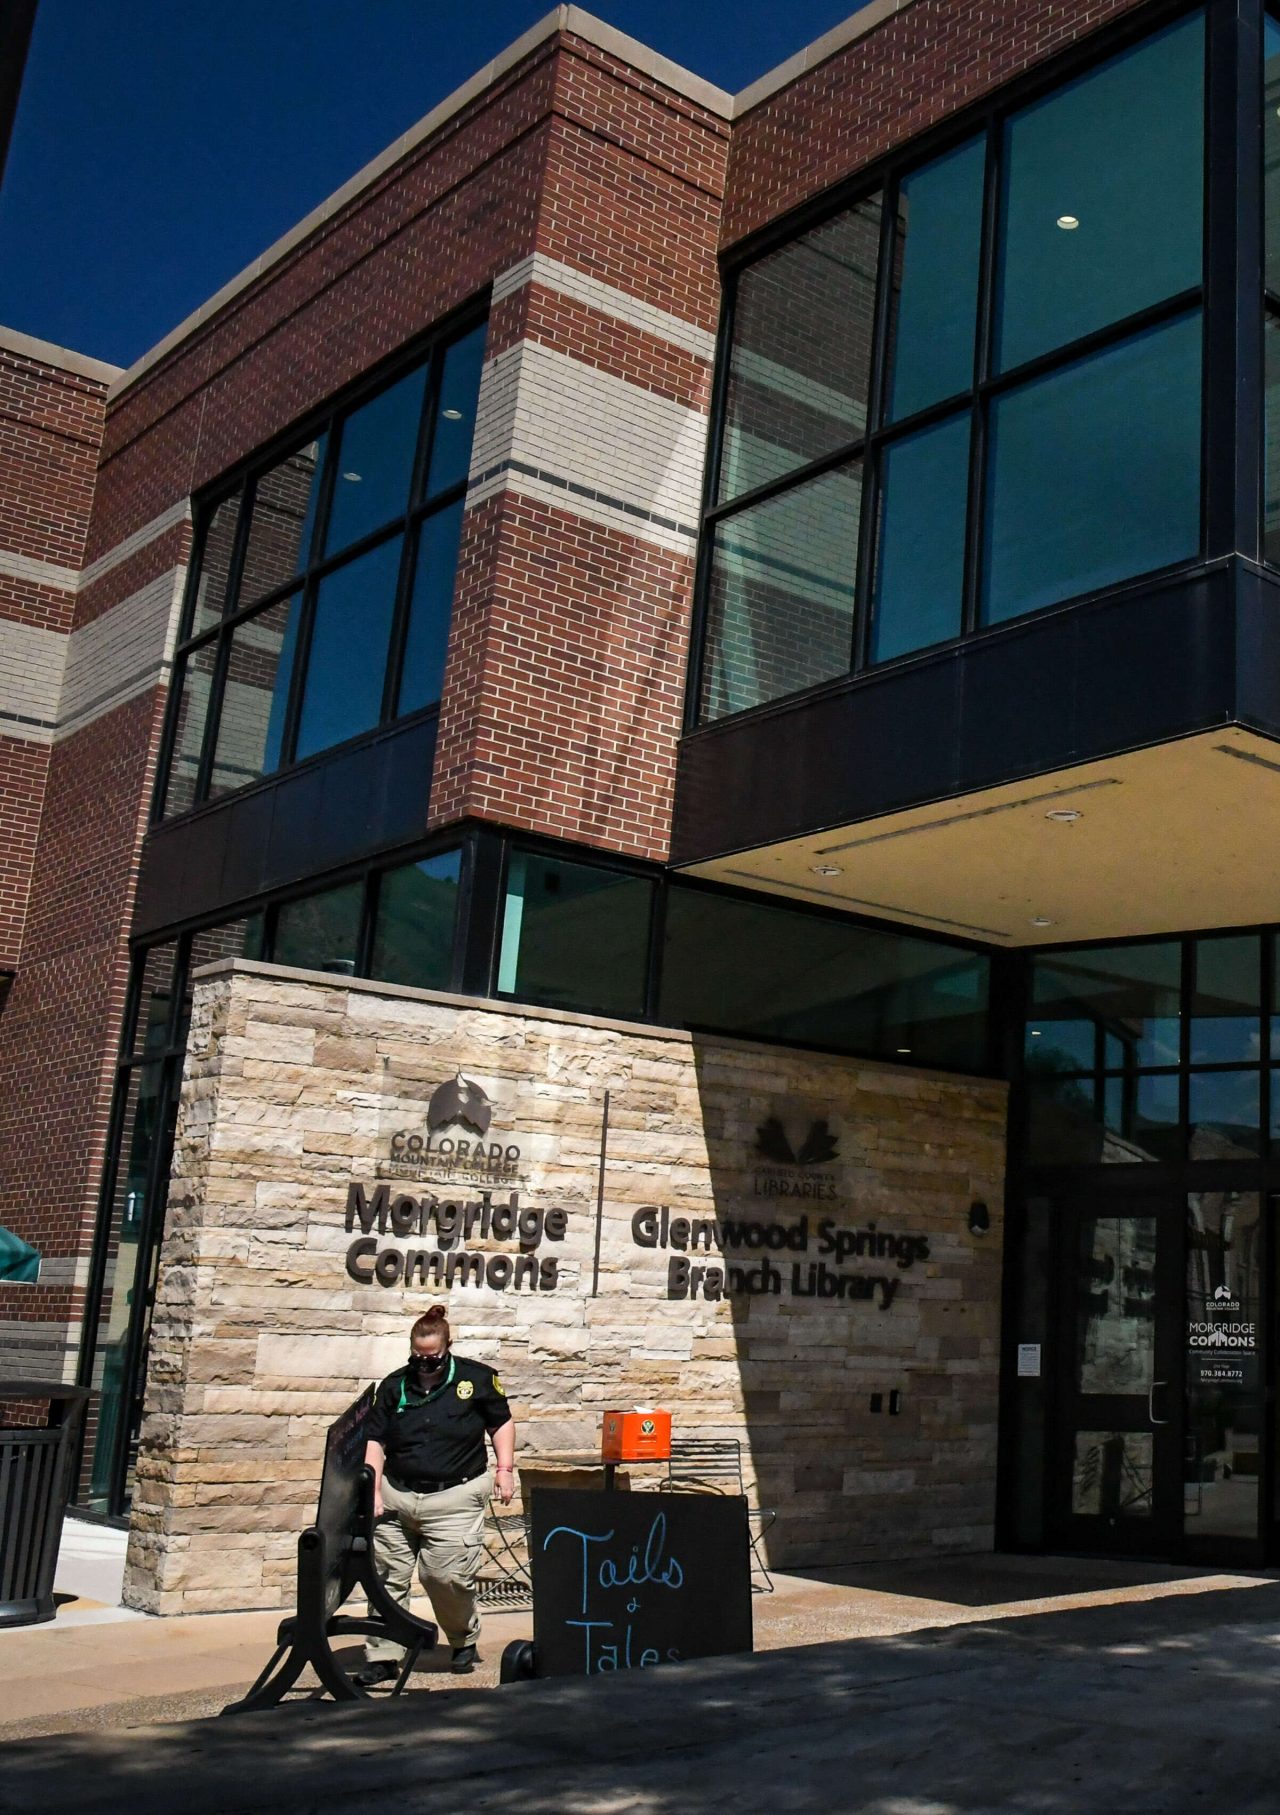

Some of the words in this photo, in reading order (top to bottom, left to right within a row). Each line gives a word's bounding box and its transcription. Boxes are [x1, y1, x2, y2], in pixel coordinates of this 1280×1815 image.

[390, 1152, 459, 1169] MOUNTAIN
[461, 1158, 520, 1174] COLLEGE
[391, 1131, 521, 1162] COLORADO
[753, 1178, 838, 1201] LIBRARIES
[345, 1182, 569, 1248] Morgridge
[632, 1205, 808, 1251] Glenwood
[818, 1219, 930, 1269] Springs
[346, 1237, 560, 1290] Commons
[668, 1256, 781, 1301] Branch
[791, 1263, 900, 1311] Library
[1189, 1322, 1256, 1334] MORGRIDGE
[1189, 1333, 1256, 1347] COMMONS
[543, 1511, 684, 1614] Tails
